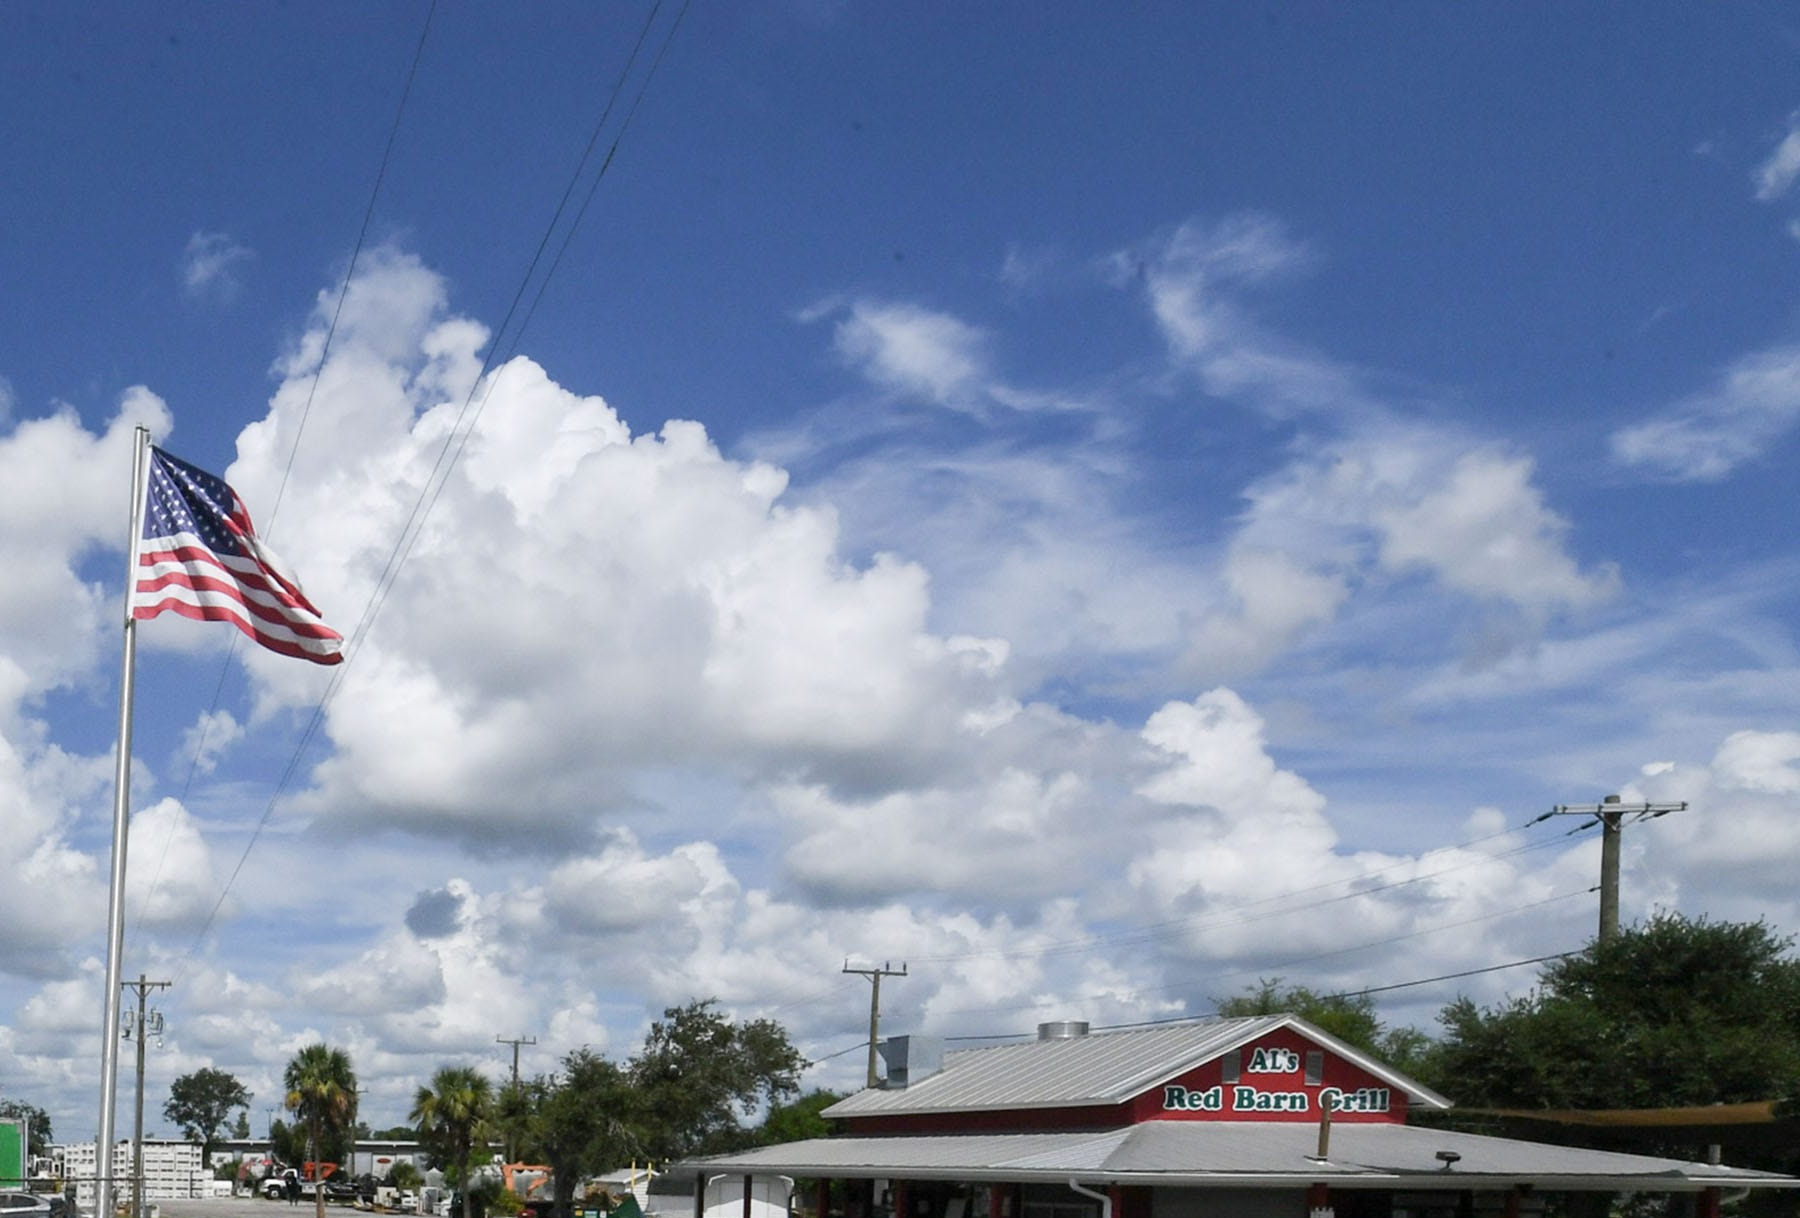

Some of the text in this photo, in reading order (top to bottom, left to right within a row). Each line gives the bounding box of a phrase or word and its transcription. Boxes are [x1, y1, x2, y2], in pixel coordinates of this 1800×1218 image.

[1249, 1048, 1299, 1072] AL's
[1163, 1085, 1389, 1112] Red Barn Grill
